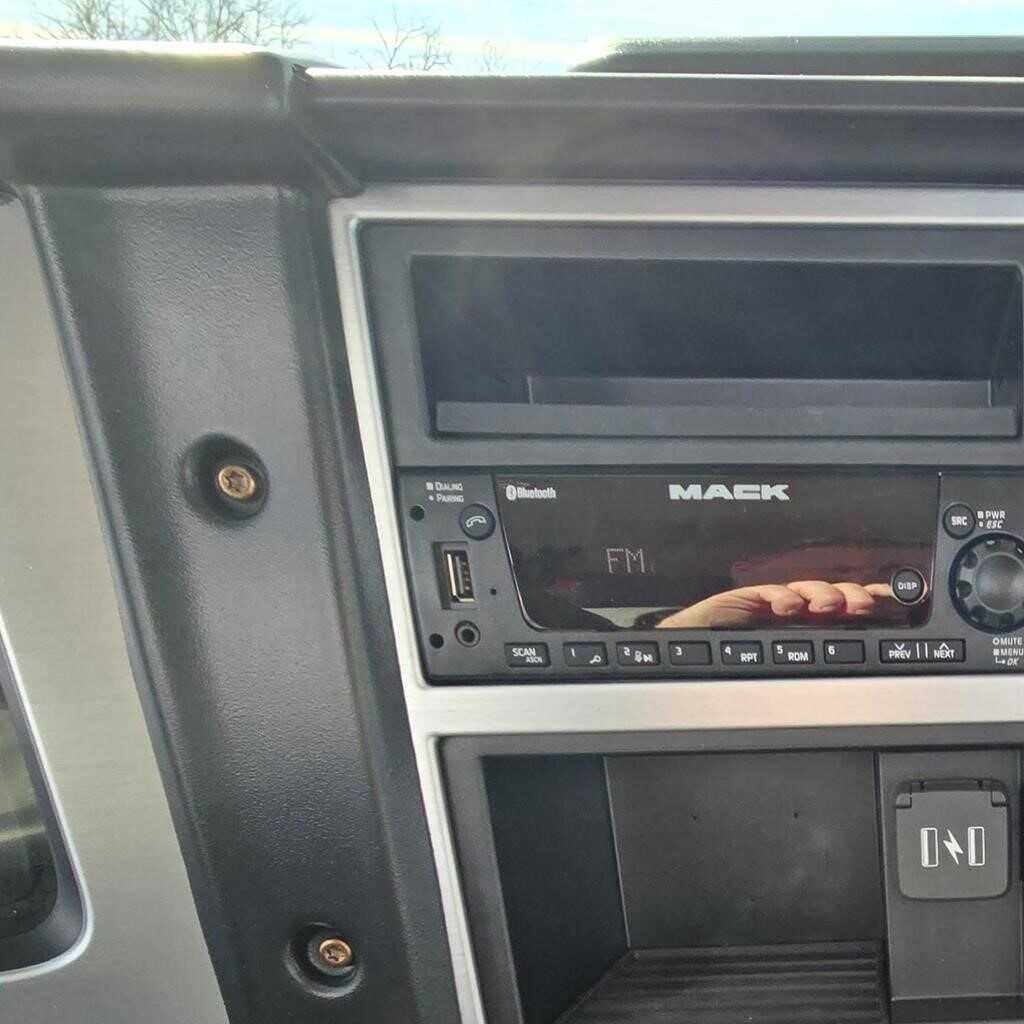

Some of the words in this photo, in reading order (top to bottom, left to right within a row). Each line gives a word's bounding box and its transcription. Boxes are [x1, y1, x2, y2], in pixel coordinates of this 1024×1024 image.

[517, 486, 557, 499] Bluetooth
[669, 484, 790, 500] MACK
[985, 510, 1005, 519] PWR
[951, 515, 967, 526] SRC
[606, 548, 645, 574] FM
[897, 581, 917, 590] DISP
[1000, 636, 1023, 646] MUTE
[511, 647, 537, 657] SCAN
[570, 647, 576, 657] 1
[675, 646, 683, 656] 3
[776, 645, 784, 654] 5
[787, 652, 809, 662] RDM
[828, 645, 836, 655] 6
[888, 649, 912, 660] PREV
[933, 649, 955, 659] NEXT
[740, 652, 758, 662] RPT
